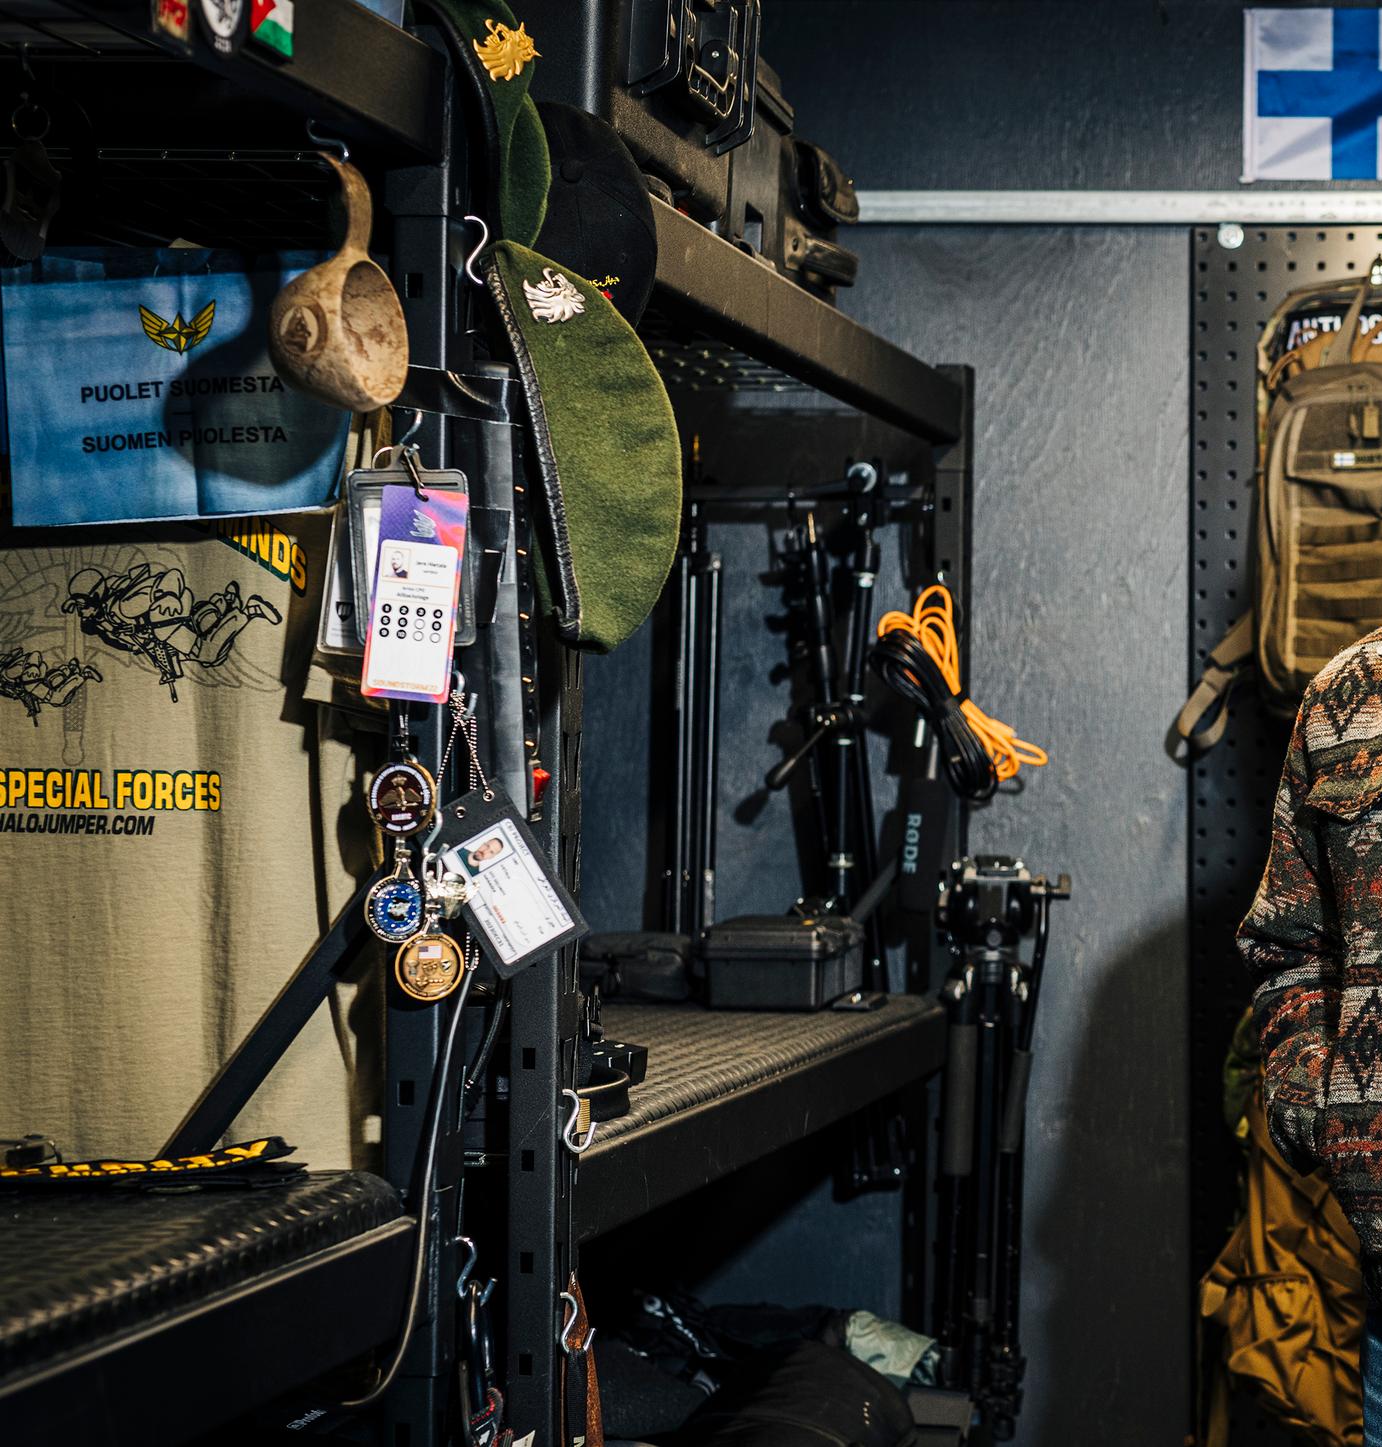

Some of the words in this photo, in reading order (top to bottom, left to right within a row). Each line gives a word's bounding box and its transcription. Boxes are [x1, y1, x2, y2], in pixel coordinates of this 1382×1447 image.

[80, 381, 164, 403] PUOLET
[170, 376, 285, 397] SUOMESTA
[82, 431, 172, 453] SUOMEN
[179, 426, 288, 447] PUOLESTA
[216, 515, 307, 597] MINDS
[114, 770, 221, 811] FORCES
